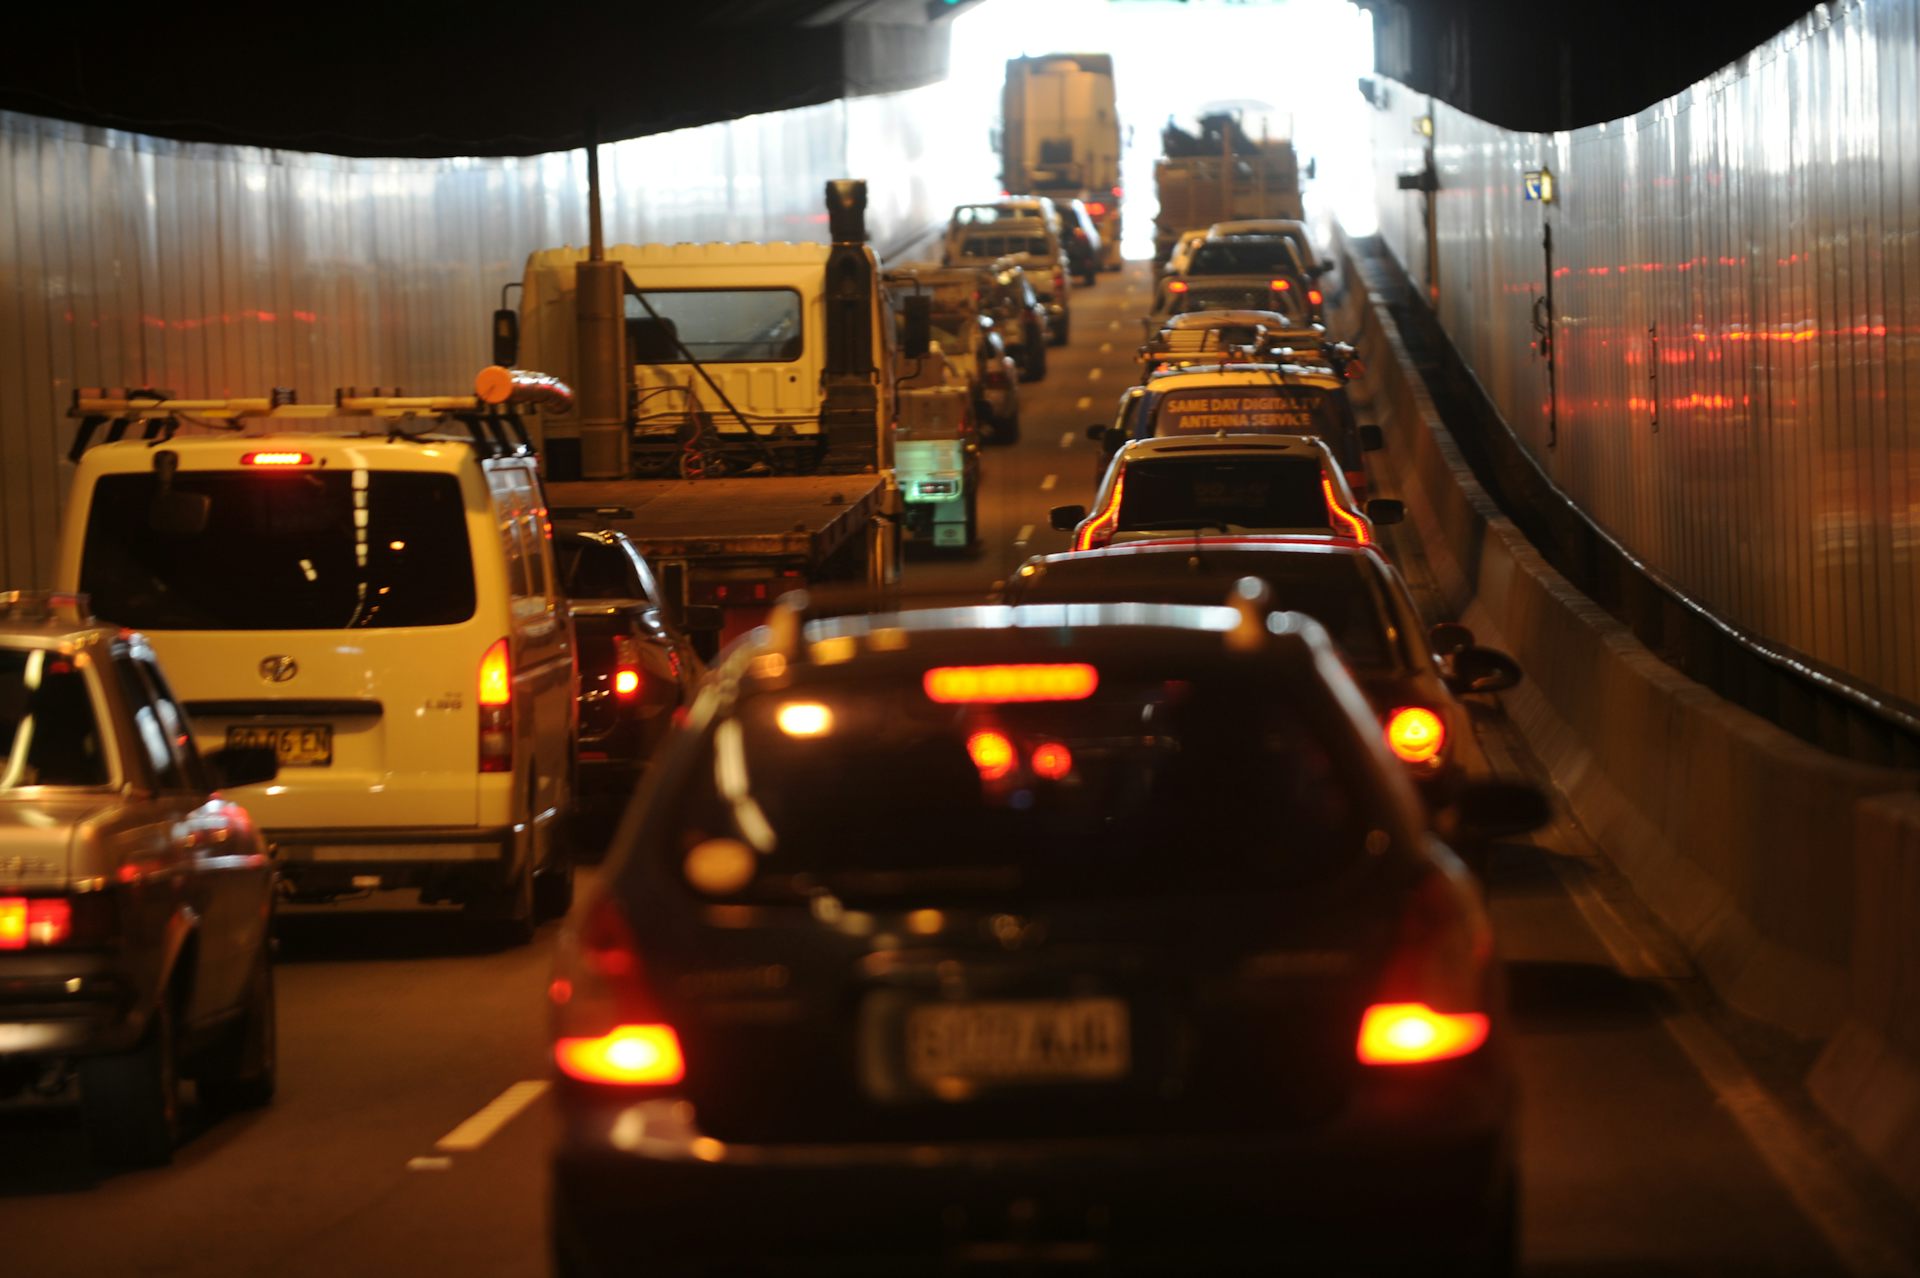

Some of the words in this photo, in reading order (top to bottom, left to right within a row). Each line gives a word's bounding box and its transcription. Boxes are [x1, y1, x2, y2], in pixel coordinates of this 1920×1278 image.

[1168, 399, 1208, 413] SAME
[1210, 398, 1240, 412] DAY
[1242, 397, 1299, 411] DIGITAL
[1179, 415, 1249, 428] ANTENNA
[1251, 413, 1311, 426] SERVICE
